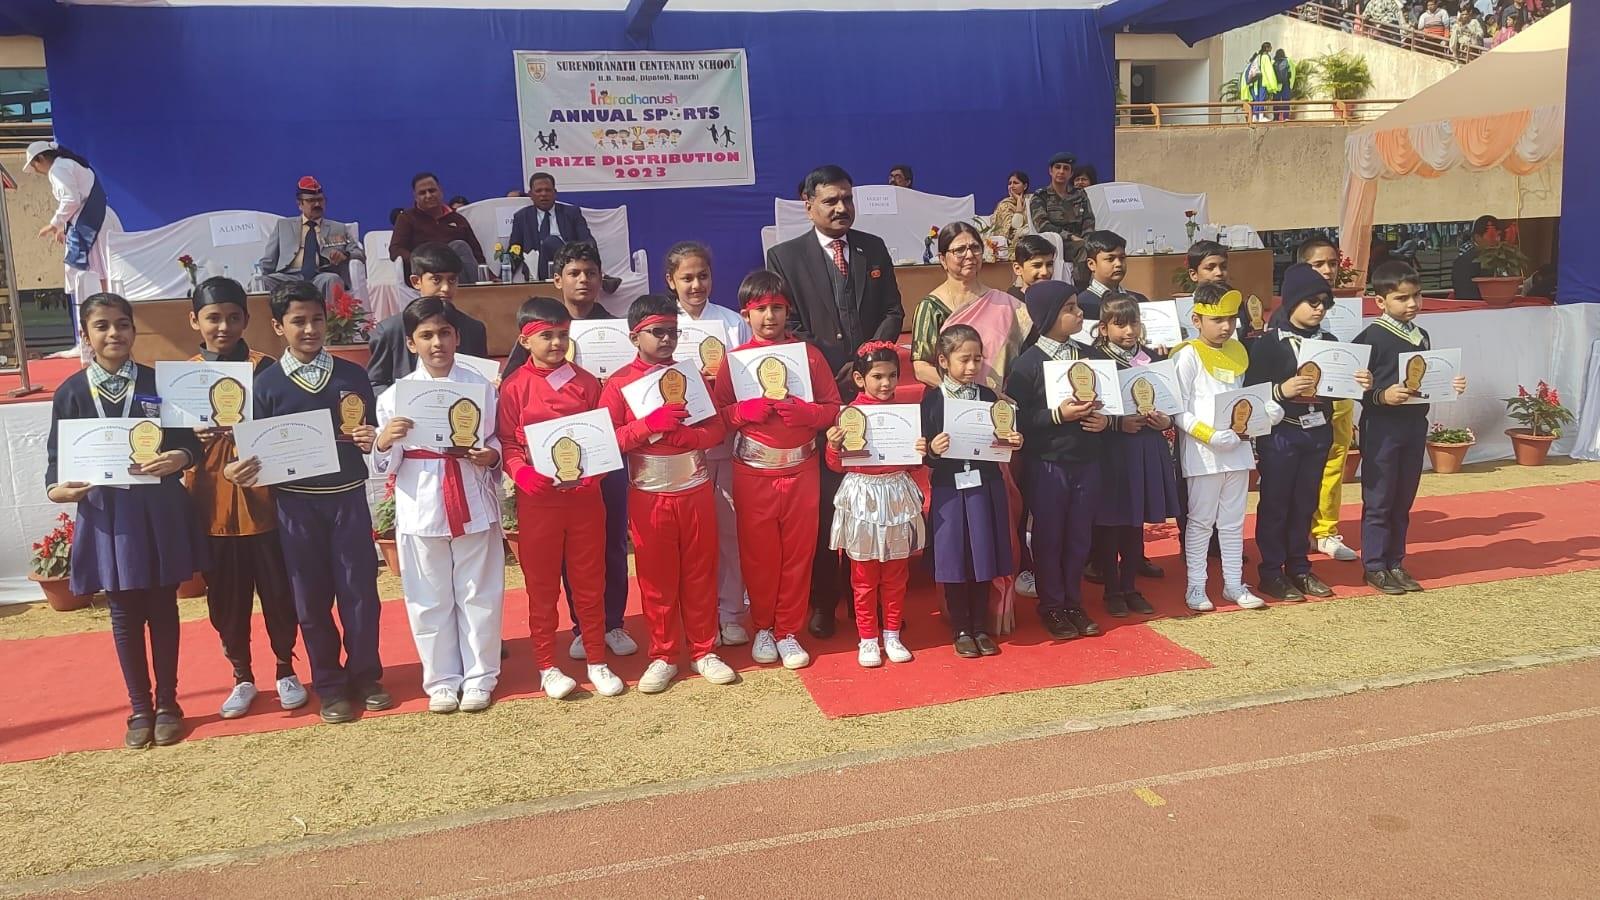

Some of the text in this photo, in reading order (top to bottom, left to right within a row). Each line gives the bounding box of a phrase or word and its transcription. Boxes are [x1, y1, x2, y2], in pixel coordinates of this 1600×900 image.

[557, 59, 737, 71] SURENDRANATH CENTENARY SCHOOL
[549, 109, 637, 123] ANNUAL
[535, 152, 740, 168] PRIZE DISTRIBUTION
[615, 167, 666, 178] 2023
[219, 223, 256, 233] ALUMNI
